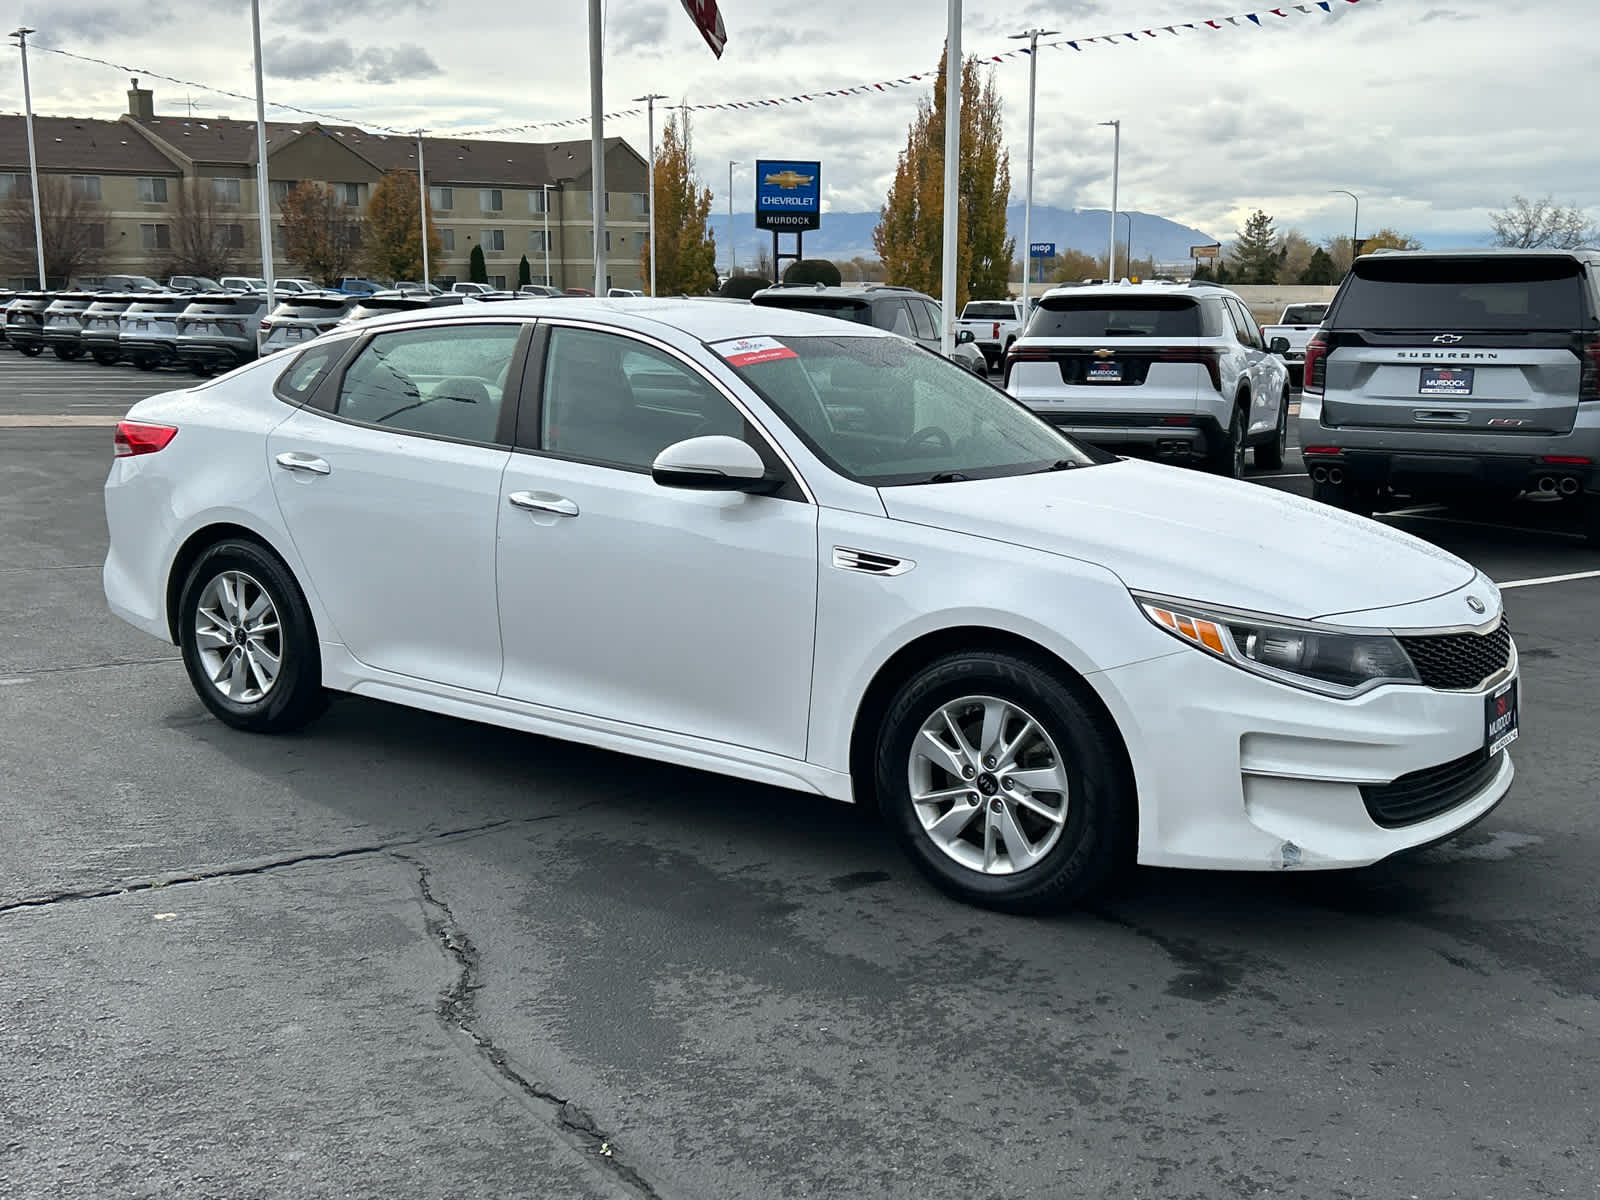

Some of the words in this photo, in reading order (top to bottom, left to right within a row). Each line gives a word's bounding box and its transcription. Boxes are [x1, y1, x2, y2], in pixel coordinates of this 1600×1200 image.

[762, 196, 814, 206] CHEVROLET
[766, 216, 810, 225] MURDOCK
[1425, 379, 1465, 387] MURDOCK
